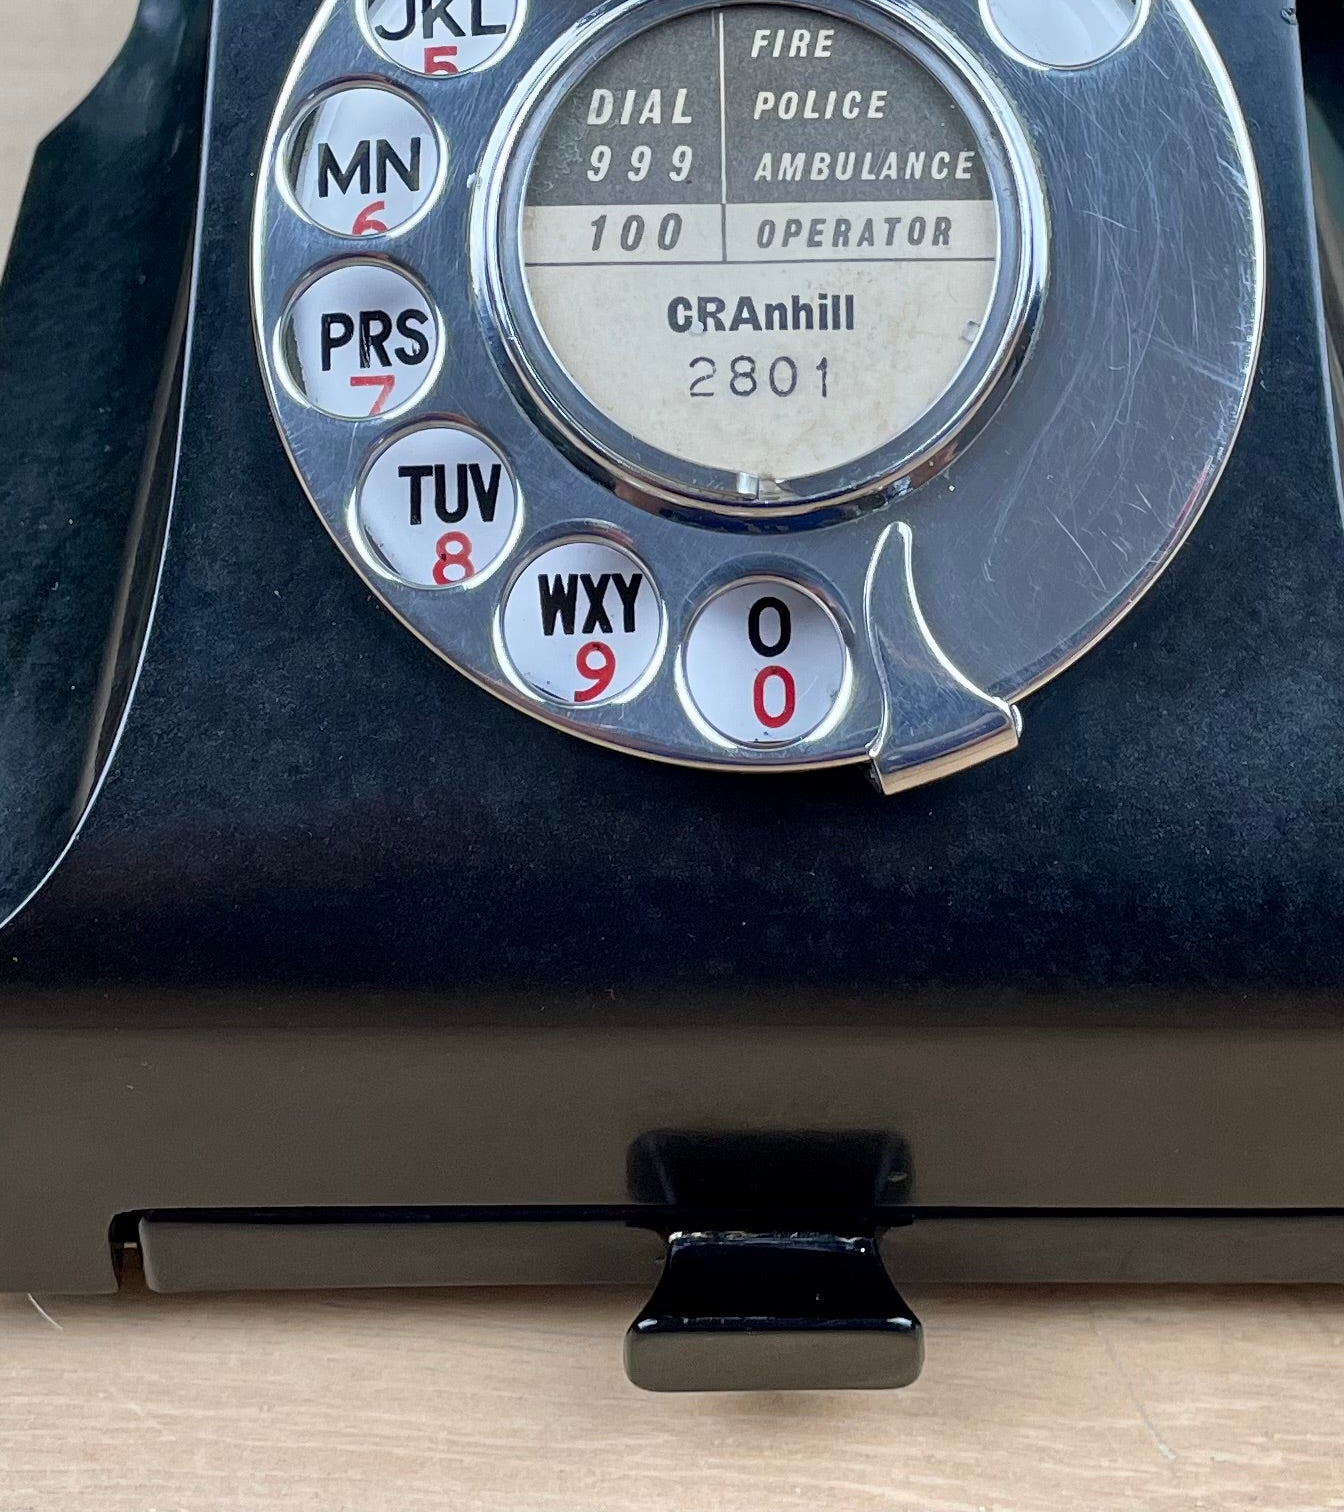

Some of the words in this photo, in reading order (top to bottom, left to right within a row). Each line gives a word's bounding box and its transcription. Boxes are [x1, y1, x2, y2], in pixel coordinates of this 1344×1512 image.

[750, 28, 835, 59] FIRE
[586, 88, 694, 126] DIAL
[753, 90, 888, 120] POLICE
[316, 139, 422, 198] MN
[754, 150, 975, 181] AMBULANCE
[589, 213, 684, 252] 100
[756, 215, 952, 249] OPERATOR
[667, 293, 855, 333] CRAnhill
[320, 309, 429, 371] PRS
[349, 375, 395, 416] 7
[688, 355, 830, 398] 2801
[399, 463, 502, 524] TUV
[432, 530, 474, 585] 8
[538, 573, 643, 635] WXY
[573, 641, 616, 703] 9
[753, 664, 796, 729] 0
